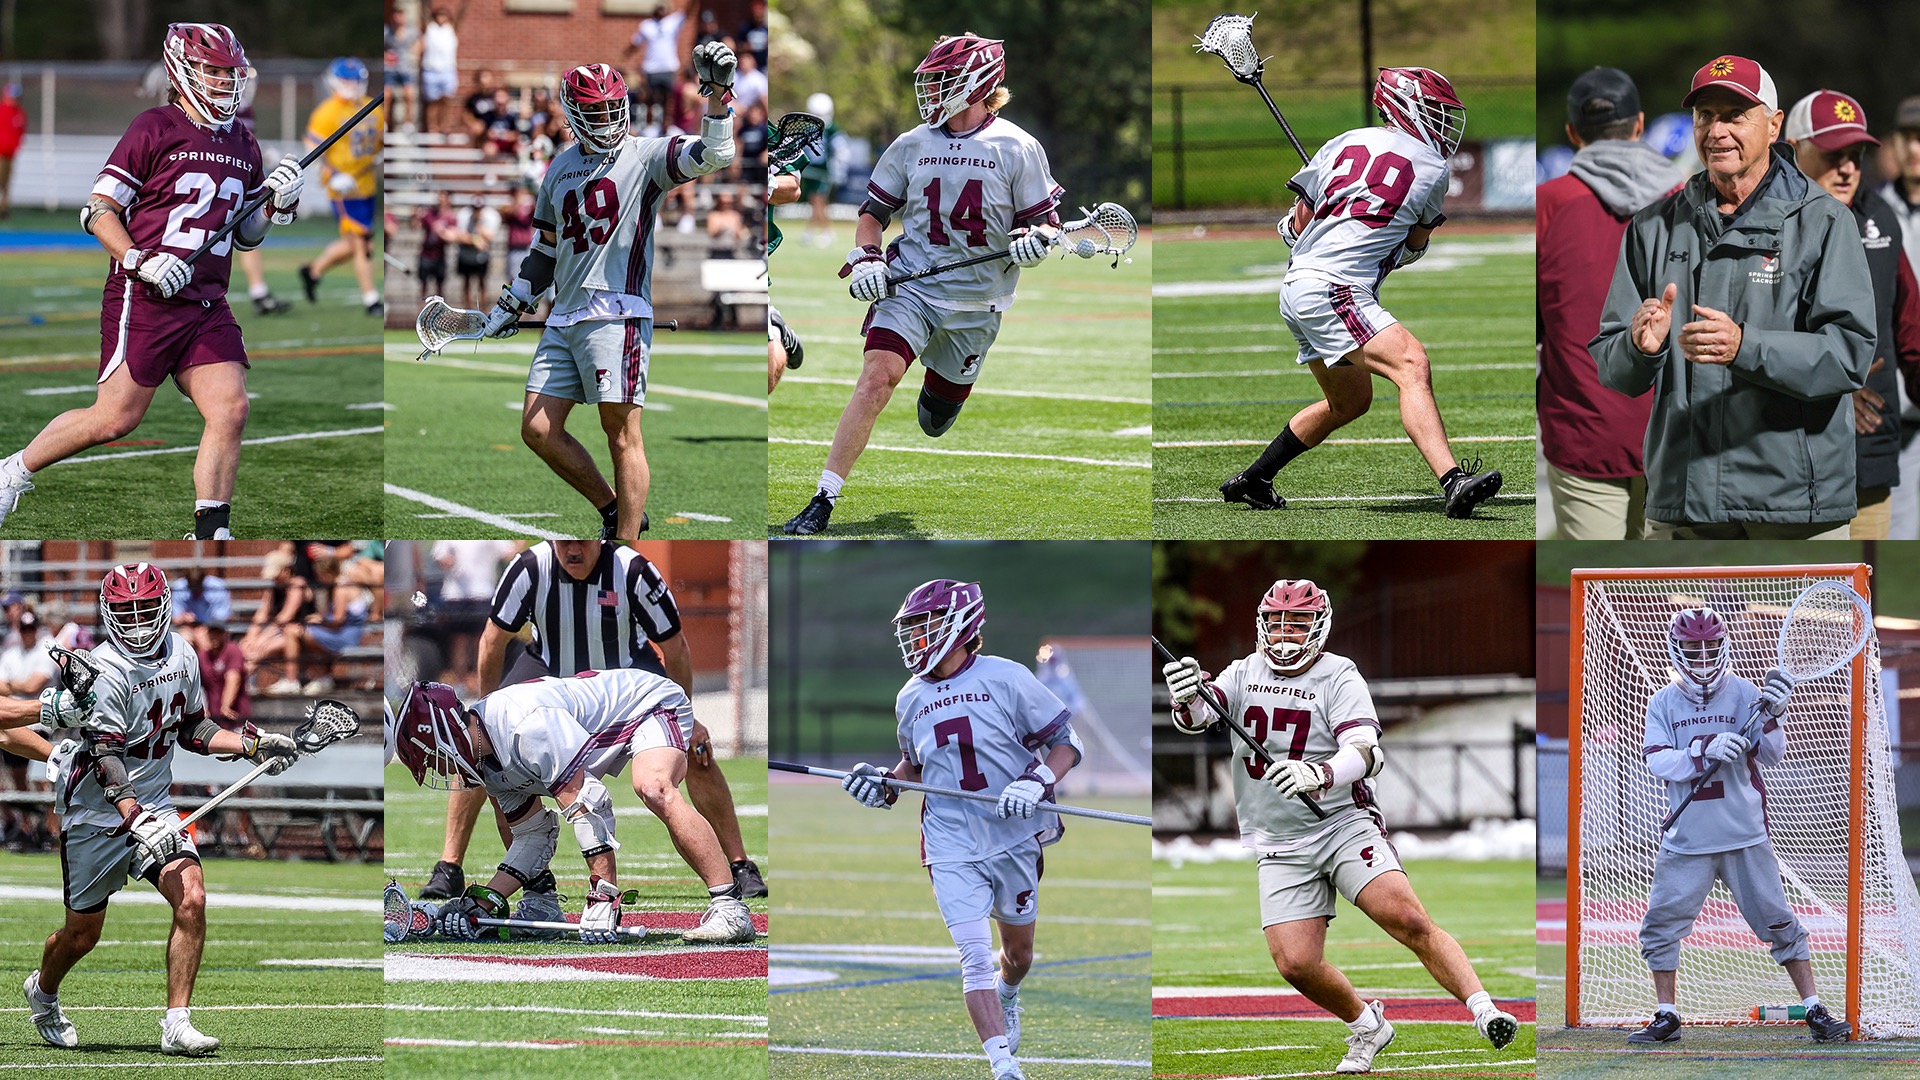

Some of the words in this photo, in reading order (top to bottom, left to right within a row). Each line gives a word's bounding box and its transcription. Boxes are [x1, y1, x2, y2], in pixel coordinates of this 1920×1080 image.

[978, 48, 994, 64] 14
[918, 156, 996, 169] SPRINGFIELD
[1314, 144, 1416, 229] 29
[161, 172, 245, 257] 23
[561, 176, 620, 255] 49
[923, 177, 989, 248] 14
[1752, 277, 1780, 285] LACROSS
[961, 590, 971, 603] 7
[914, 693, 990, 722] SPRINGFIELD
[1246, 684, 1316, 701] PRINGFIELD
[933, 715, 989, 792] 7
[1242, 705, 1312, 780] 37
